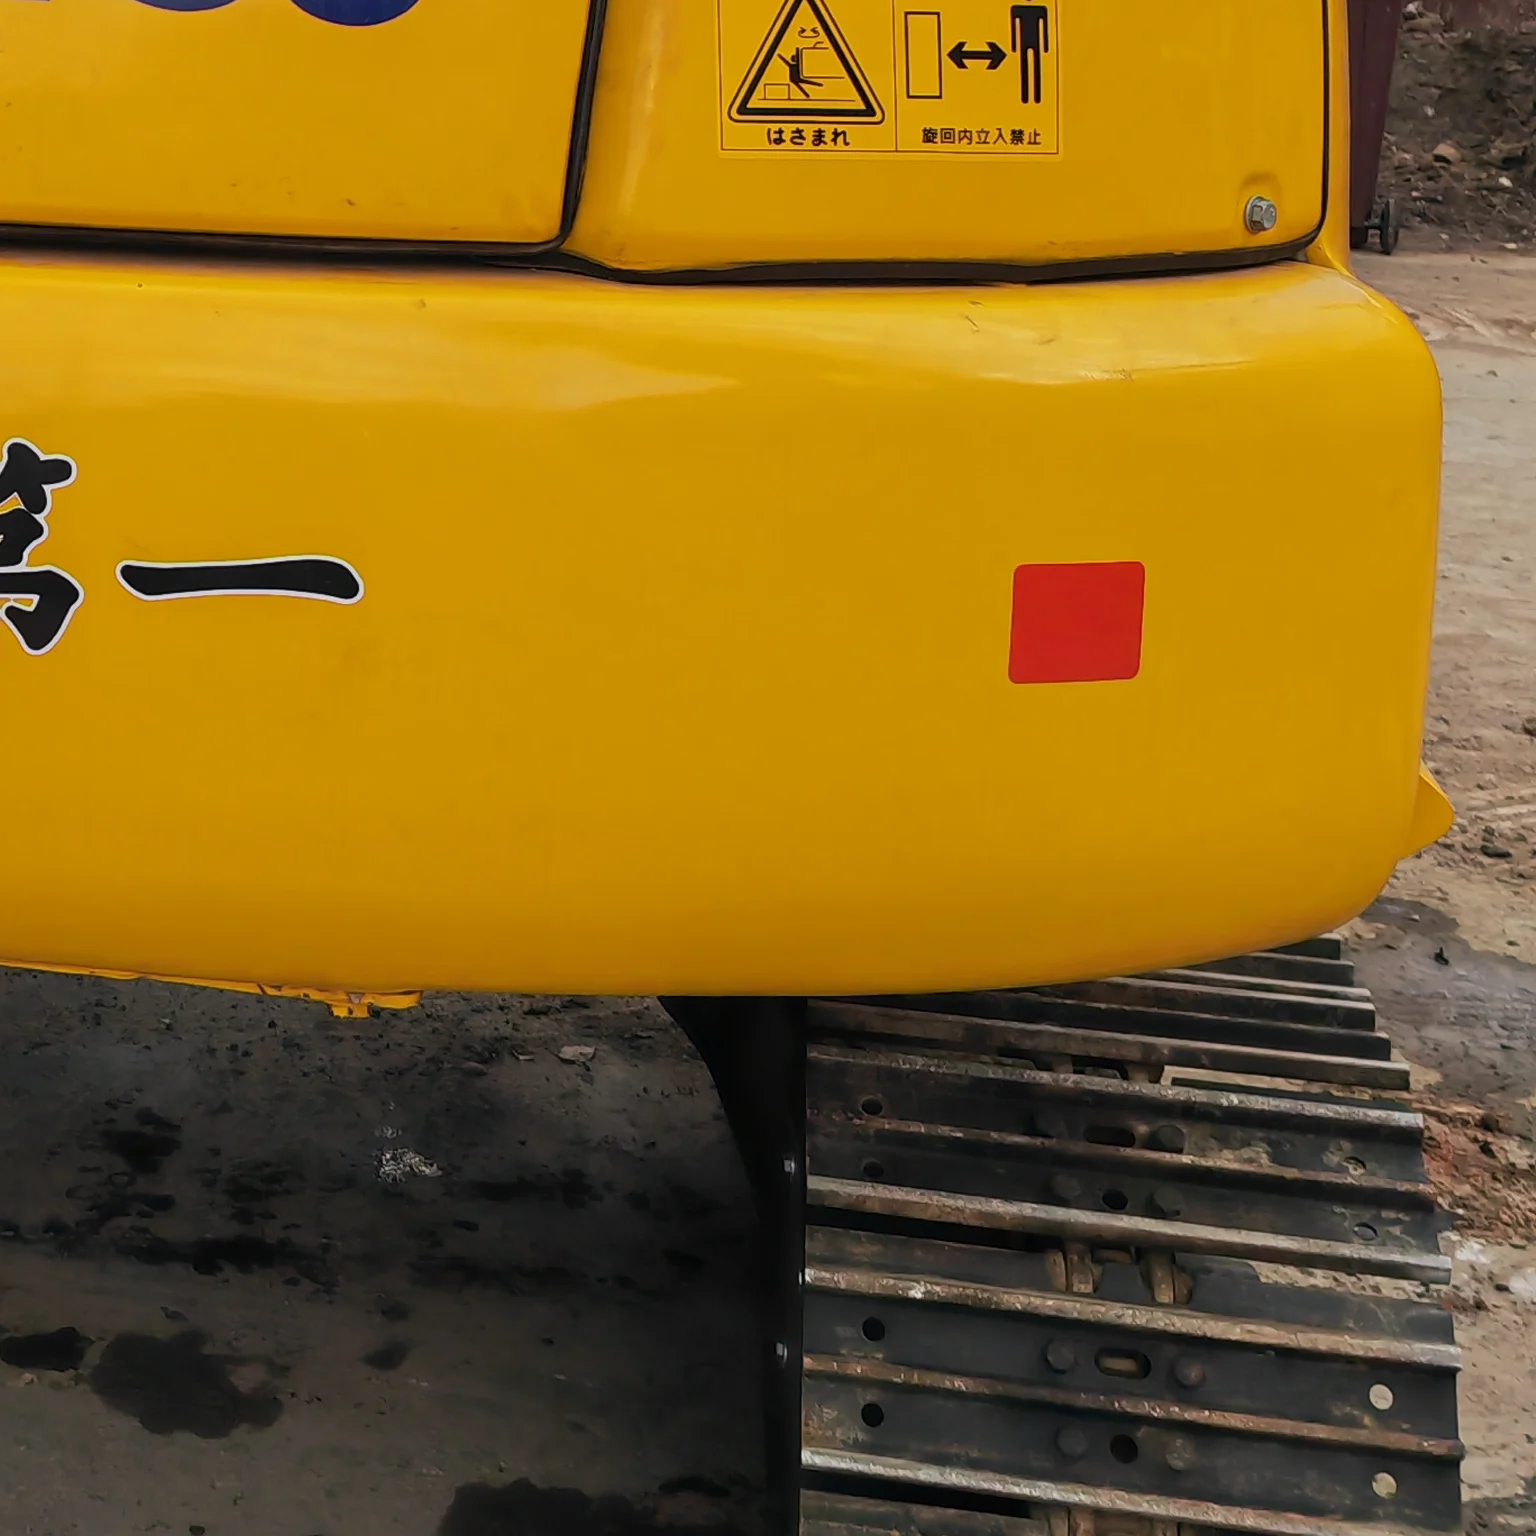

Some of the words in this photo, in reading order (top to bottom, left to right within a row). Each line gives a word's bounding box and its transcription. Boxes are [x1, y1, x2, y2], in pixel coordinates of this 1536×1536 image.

[766, 127, 851, 147] はさまれ
[921, 126, 1043, 147] 旋回内立入禁止
